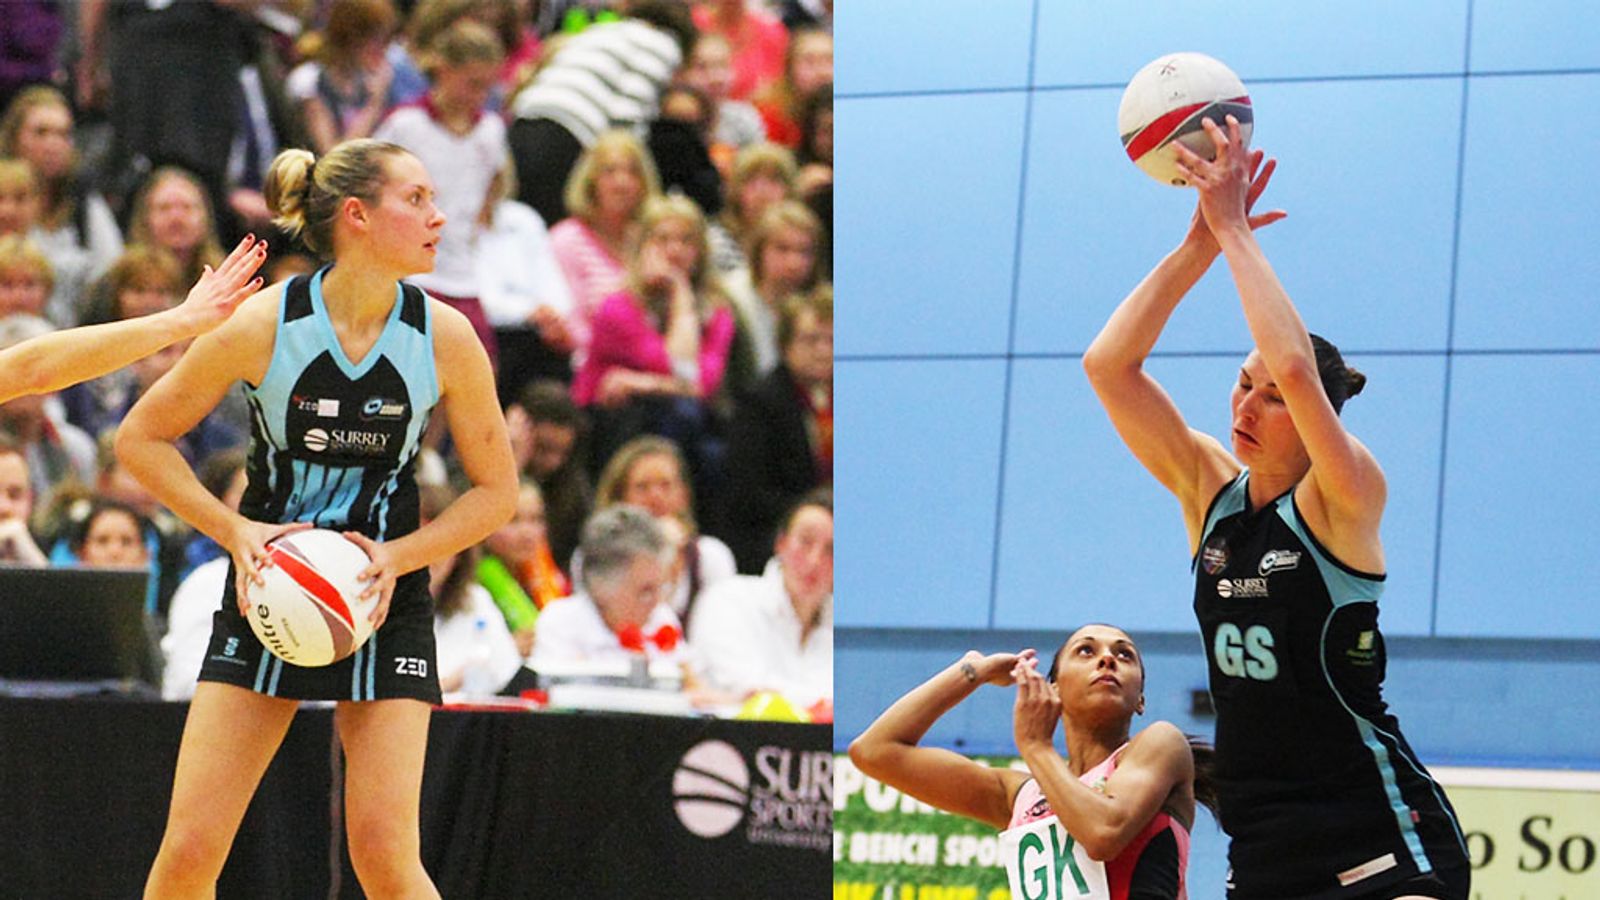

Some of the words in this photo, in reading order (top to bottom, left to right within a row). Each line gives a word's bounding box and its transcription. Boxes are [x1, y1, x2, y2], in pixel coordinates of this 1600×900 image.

[331, 429, 390, 446] SURREY
[1214, 622, 1278, 681] GS
[755, 745, 833, 802] SUR
[850, 831, 938, 865] BENCH
[1018, 823, 1091, 900] GK
[1518, 815, 1596, 875] So
